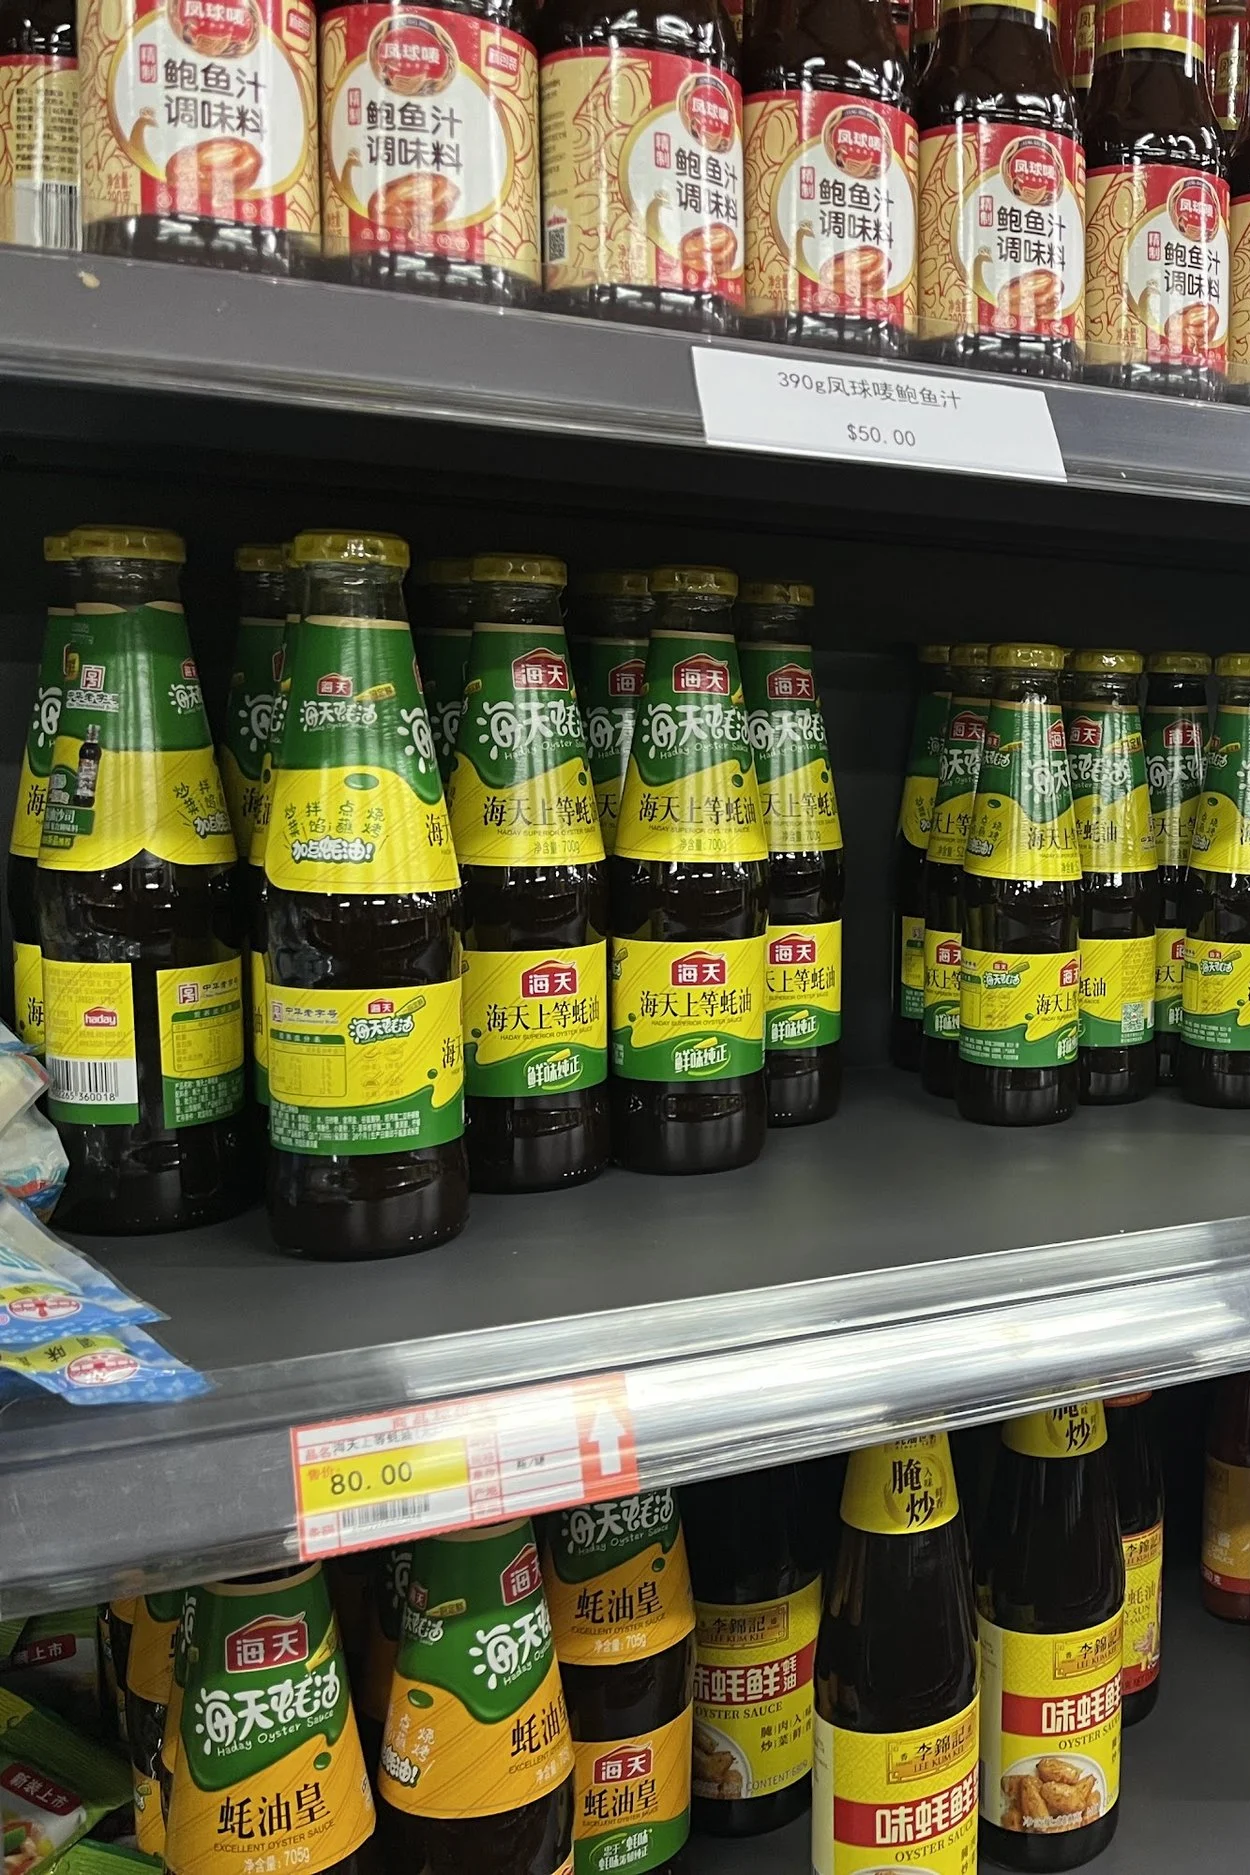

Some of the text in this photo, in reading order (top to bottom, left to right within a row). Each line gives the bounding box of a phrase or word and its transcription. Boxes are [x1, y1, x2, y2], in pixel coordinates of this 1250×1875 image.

[163, 57, 267, 102] 鲍鱼汁
[164, 95, 266, 139] 调味料
[366, 100, 463, 138] 鲍鱼汁
[367, 135, 463, 173] 调味料
[675, 148, 738, 192] 鲍鱼汁
[676, 181, 738, 227] 调味料
[818, 178, 894, 217] 鲍鱼汁
[819, 209, 893, 249] 调味料
[997, 206, 1067, 239] 鲍鱼汁
[997, 236, 1066, 270] 调味料
[1164, 241, 1221, 275] 鲍鱼汁
[1164, 269, 1220, 303] 调味料
[777, 371, 962, 409] 390g凤球唛鲍鱼汁
[846, 423, 917, 447] $50.00
[521, 663, 566, 686] 海天
[681, 667, 724, 691] 海天
[774, 675, 811, 697] 海天
[639, 793, 757, 826] 海天上等蚝油
[775, 944, 812, 963] 海天
[528, 973, 573, 995] 海天
[678, 963, 721, 983] 海天
[486, 995, 600, 1033] 海天上等蚝油
[640, 987, 752, 1018] 海天上等蚝油
[85, 1014, 117, 1027] haday
[771, 1015, 817, 1042] 鲜味纯正
[527, 1054, 580, 1089] 鲜味纯正
[675, 1043, 728, 1074] 鲜味纯正
[1065, 1417, 1091, 1452] 炒
[331, 1460, 413, 1495] 80.00
[906, 1490, 936, 1529] 炒
[575, 1582, 662, 1624] 蚝油皇
[236, 1630, 299, 1667] 海天
[195, 1661, 340, 1756] 海天蚝油
[743, 1701, 783, 1719] SAUCE
[217, 1709, 335, 1757] Haday Oyster Sauce
[1058, 1730, 1101, 1750] OYSTER
[602, 1753, 647, 1781] 海天
[216, 1782, 332, 1840] 蚝油皇
[583, 1778, 659, 1820] 蚝油皇
[213, 1819, 335, 1853] EXCELLENT OYSTER SAUCE
[895, 1840, 945, 1864] OYSTER
